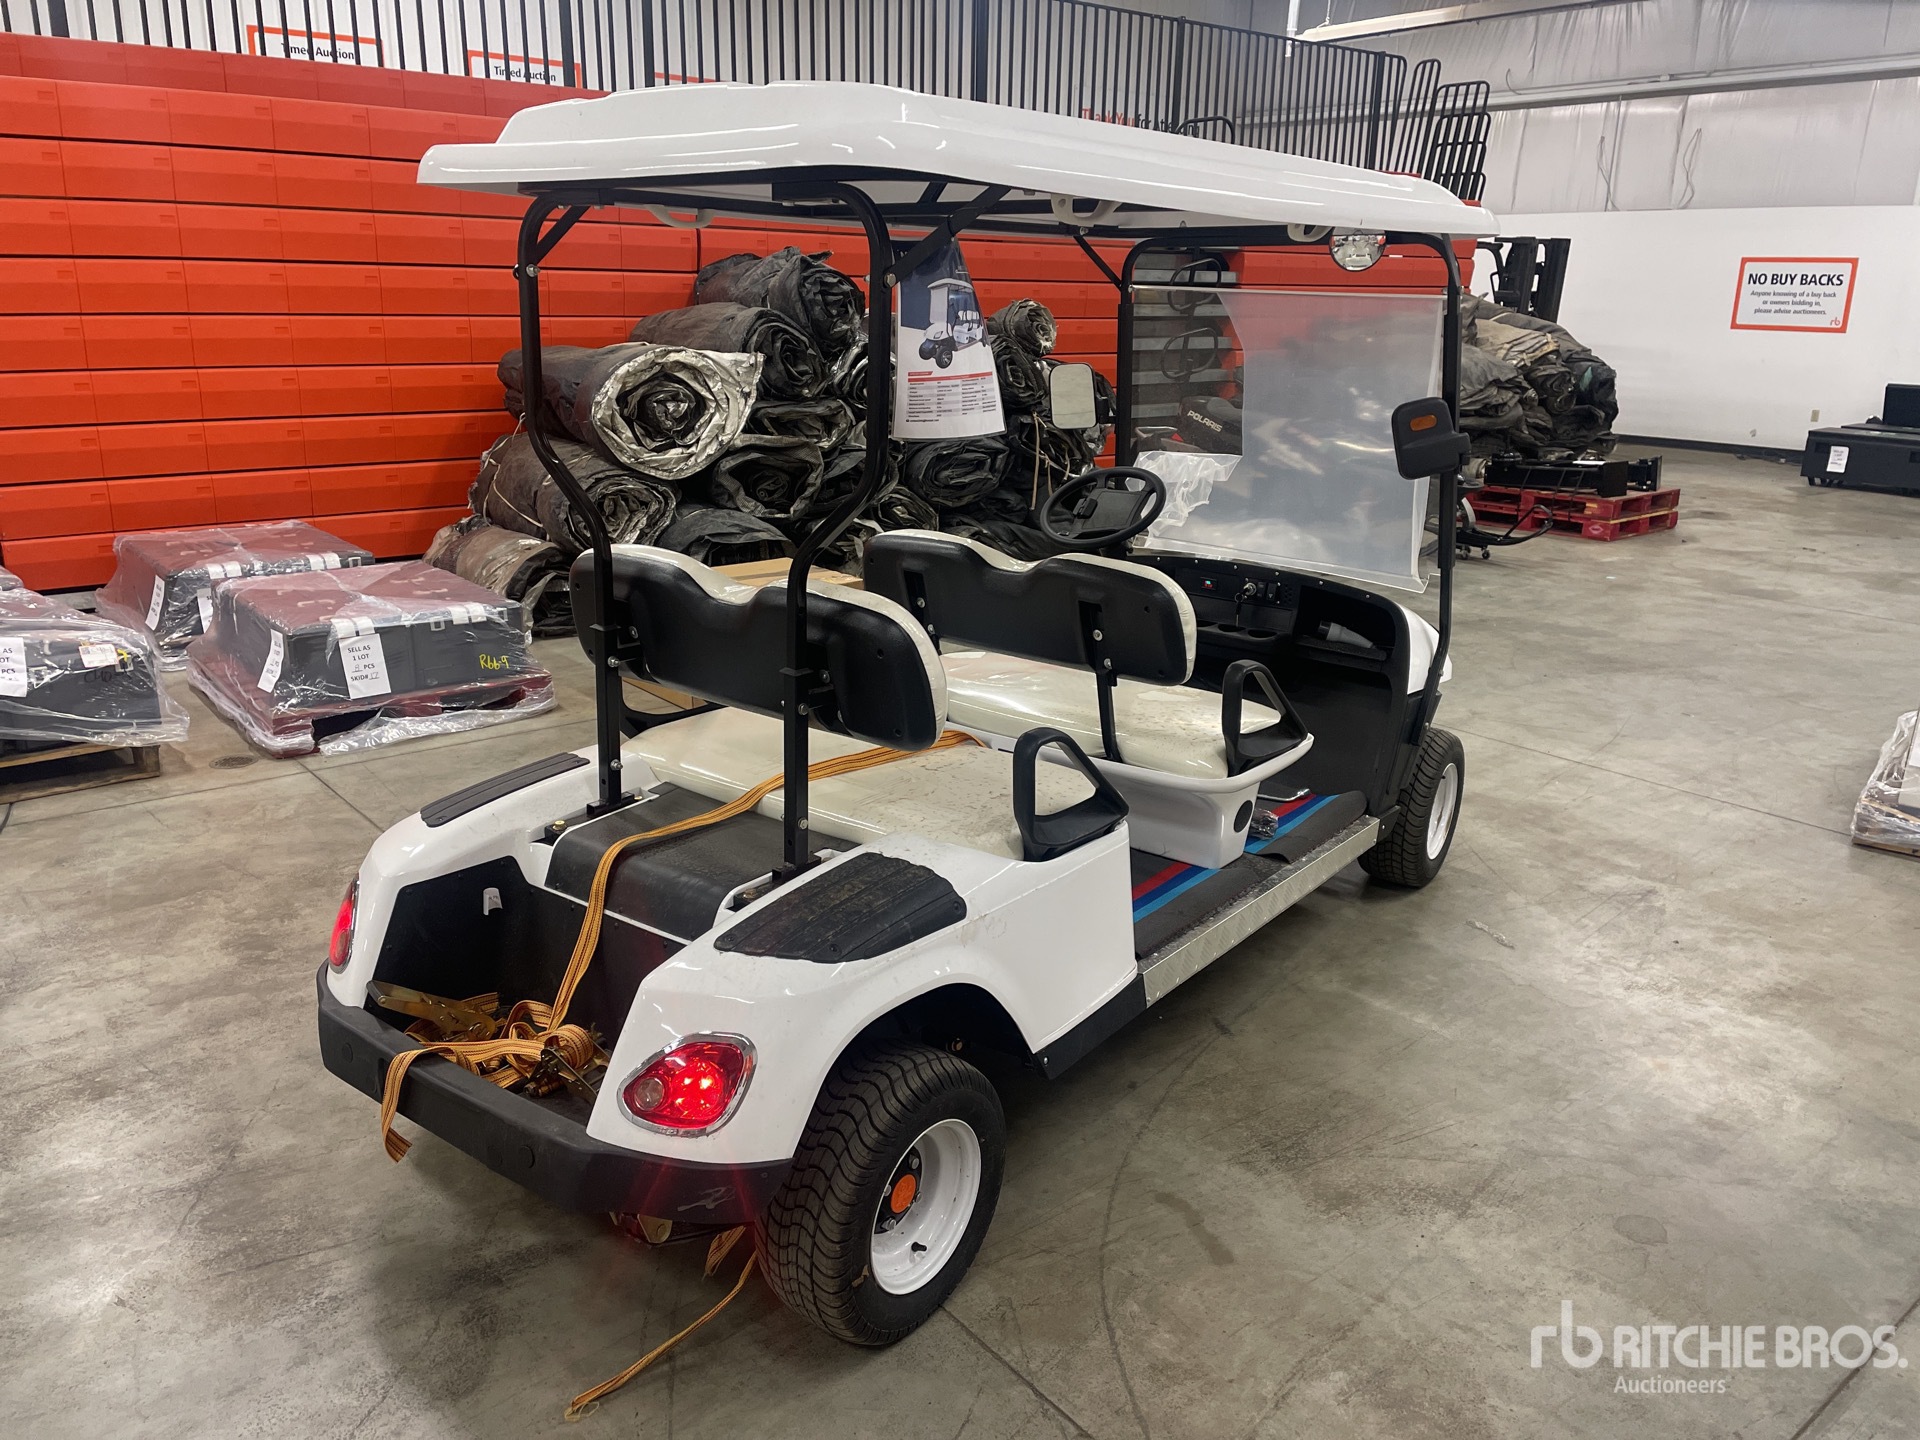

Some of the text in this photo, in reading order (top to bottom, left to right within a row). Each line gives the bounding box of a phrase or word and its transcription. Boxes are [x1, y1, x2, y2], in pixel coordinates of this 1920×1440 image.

[315, 46, 355, 60] Auion
[1747, 273, 1844, 287] NO BUY BACKS
[1750, 290, 1772, 298] Anyone
[1772, 290, 1798, 299] knowing
[1811, 291, 1822, 299] buy
[1791, 299, 1814, 307] bidding
[1187, 410, 1223, 433] POLARIS
[347, 646, 362, 654] SELL
[350, 674, 369, 682] SKID#
